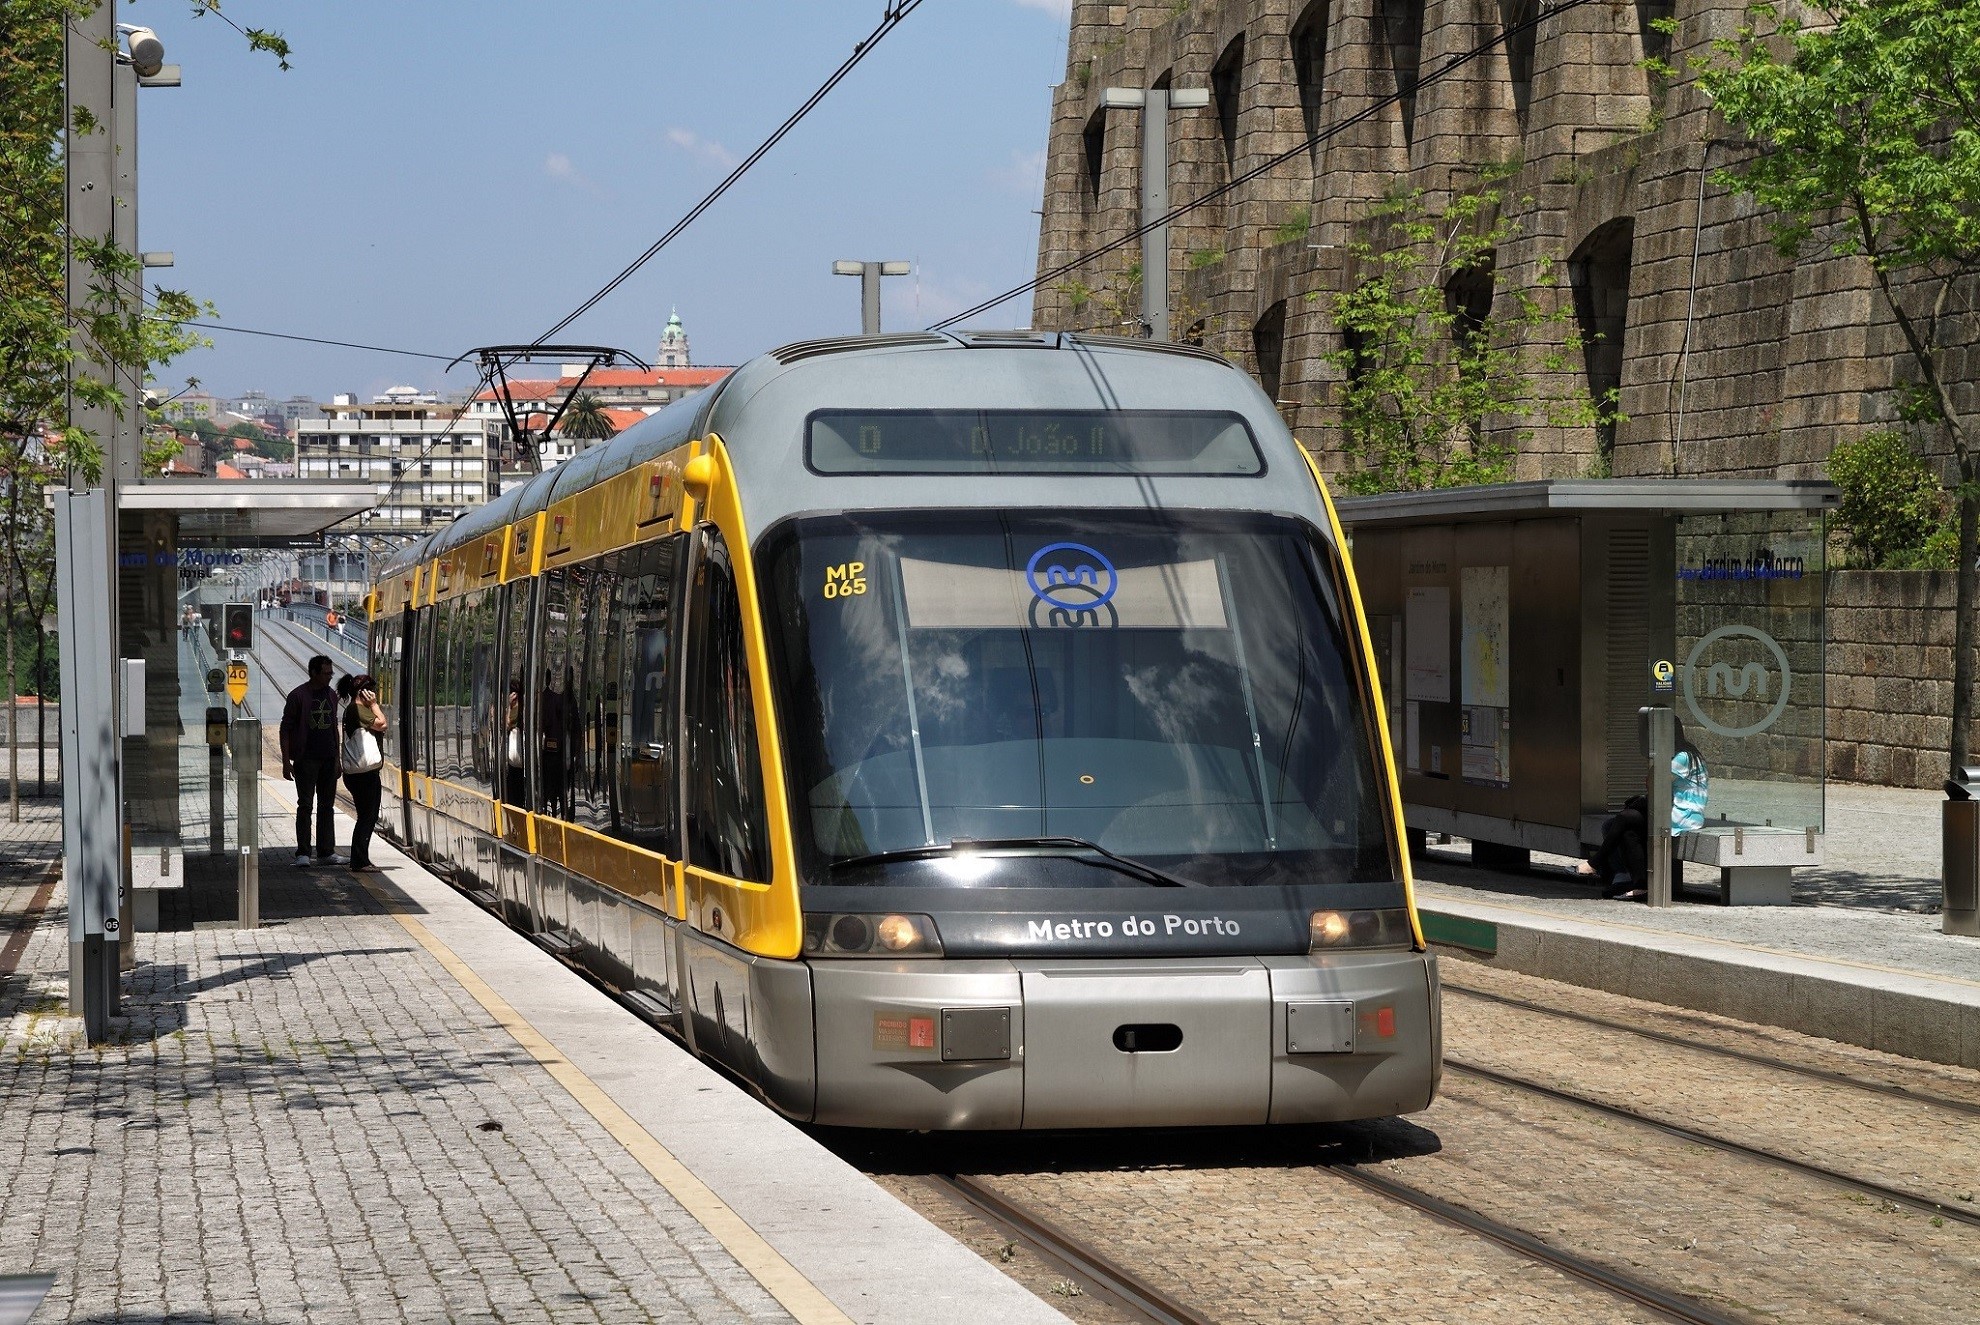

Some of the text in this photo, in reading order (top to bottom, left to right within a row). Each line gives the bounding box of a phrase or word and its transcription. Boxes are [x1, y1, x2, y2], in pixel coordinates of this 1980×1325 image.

[1008, 423, 1078, 454] João
[186, 548, 243, 566] Morro
[826, 561, 865, 583] MP
[824, 578, 867, 599] 065
[229, 669, 247, 680] 40
[106, 921, 118, 929] 05
[1027, 914, 1241, 942] Metro do Porto
